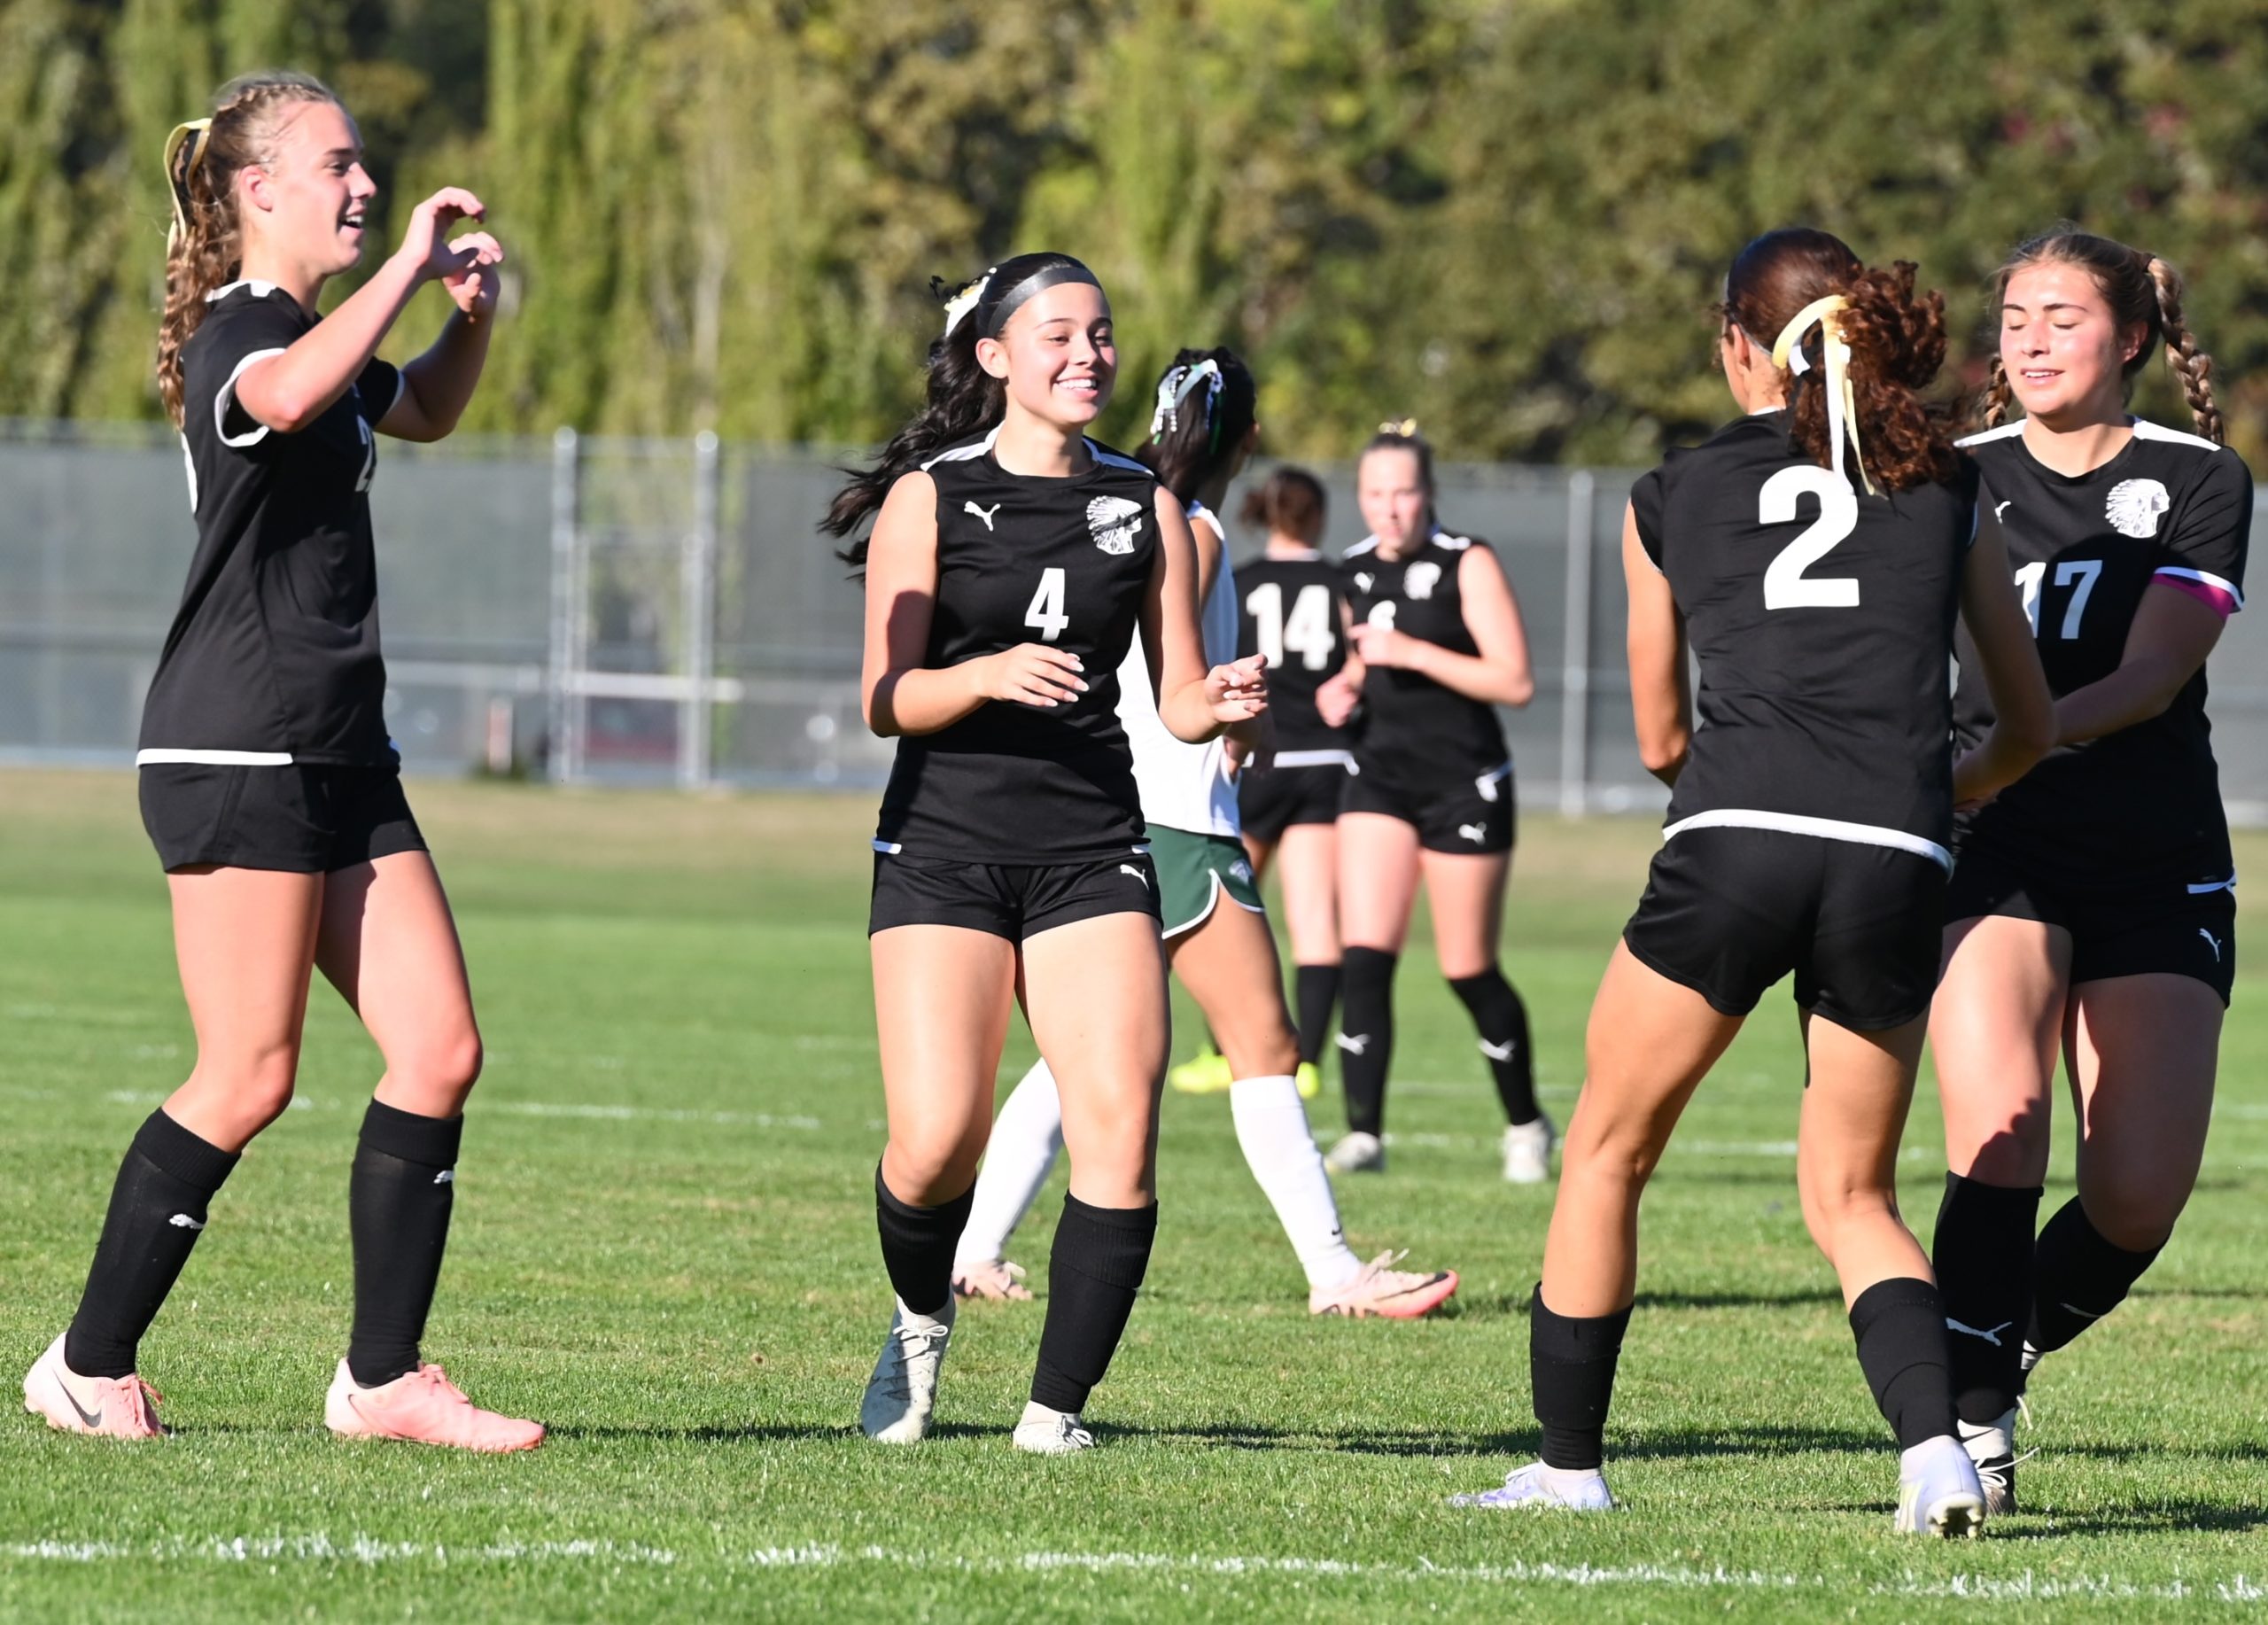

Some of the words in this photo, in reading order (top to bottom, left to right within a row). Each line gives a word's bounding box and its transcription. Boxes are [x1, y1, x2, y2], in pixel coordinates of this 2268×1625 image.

[1759, 464, 1860, 610] 2
[1024, 567, 1069, 641] 4
[1246, 582, 1336, 671] 14
[2014, 559, 2103, 640] 17
